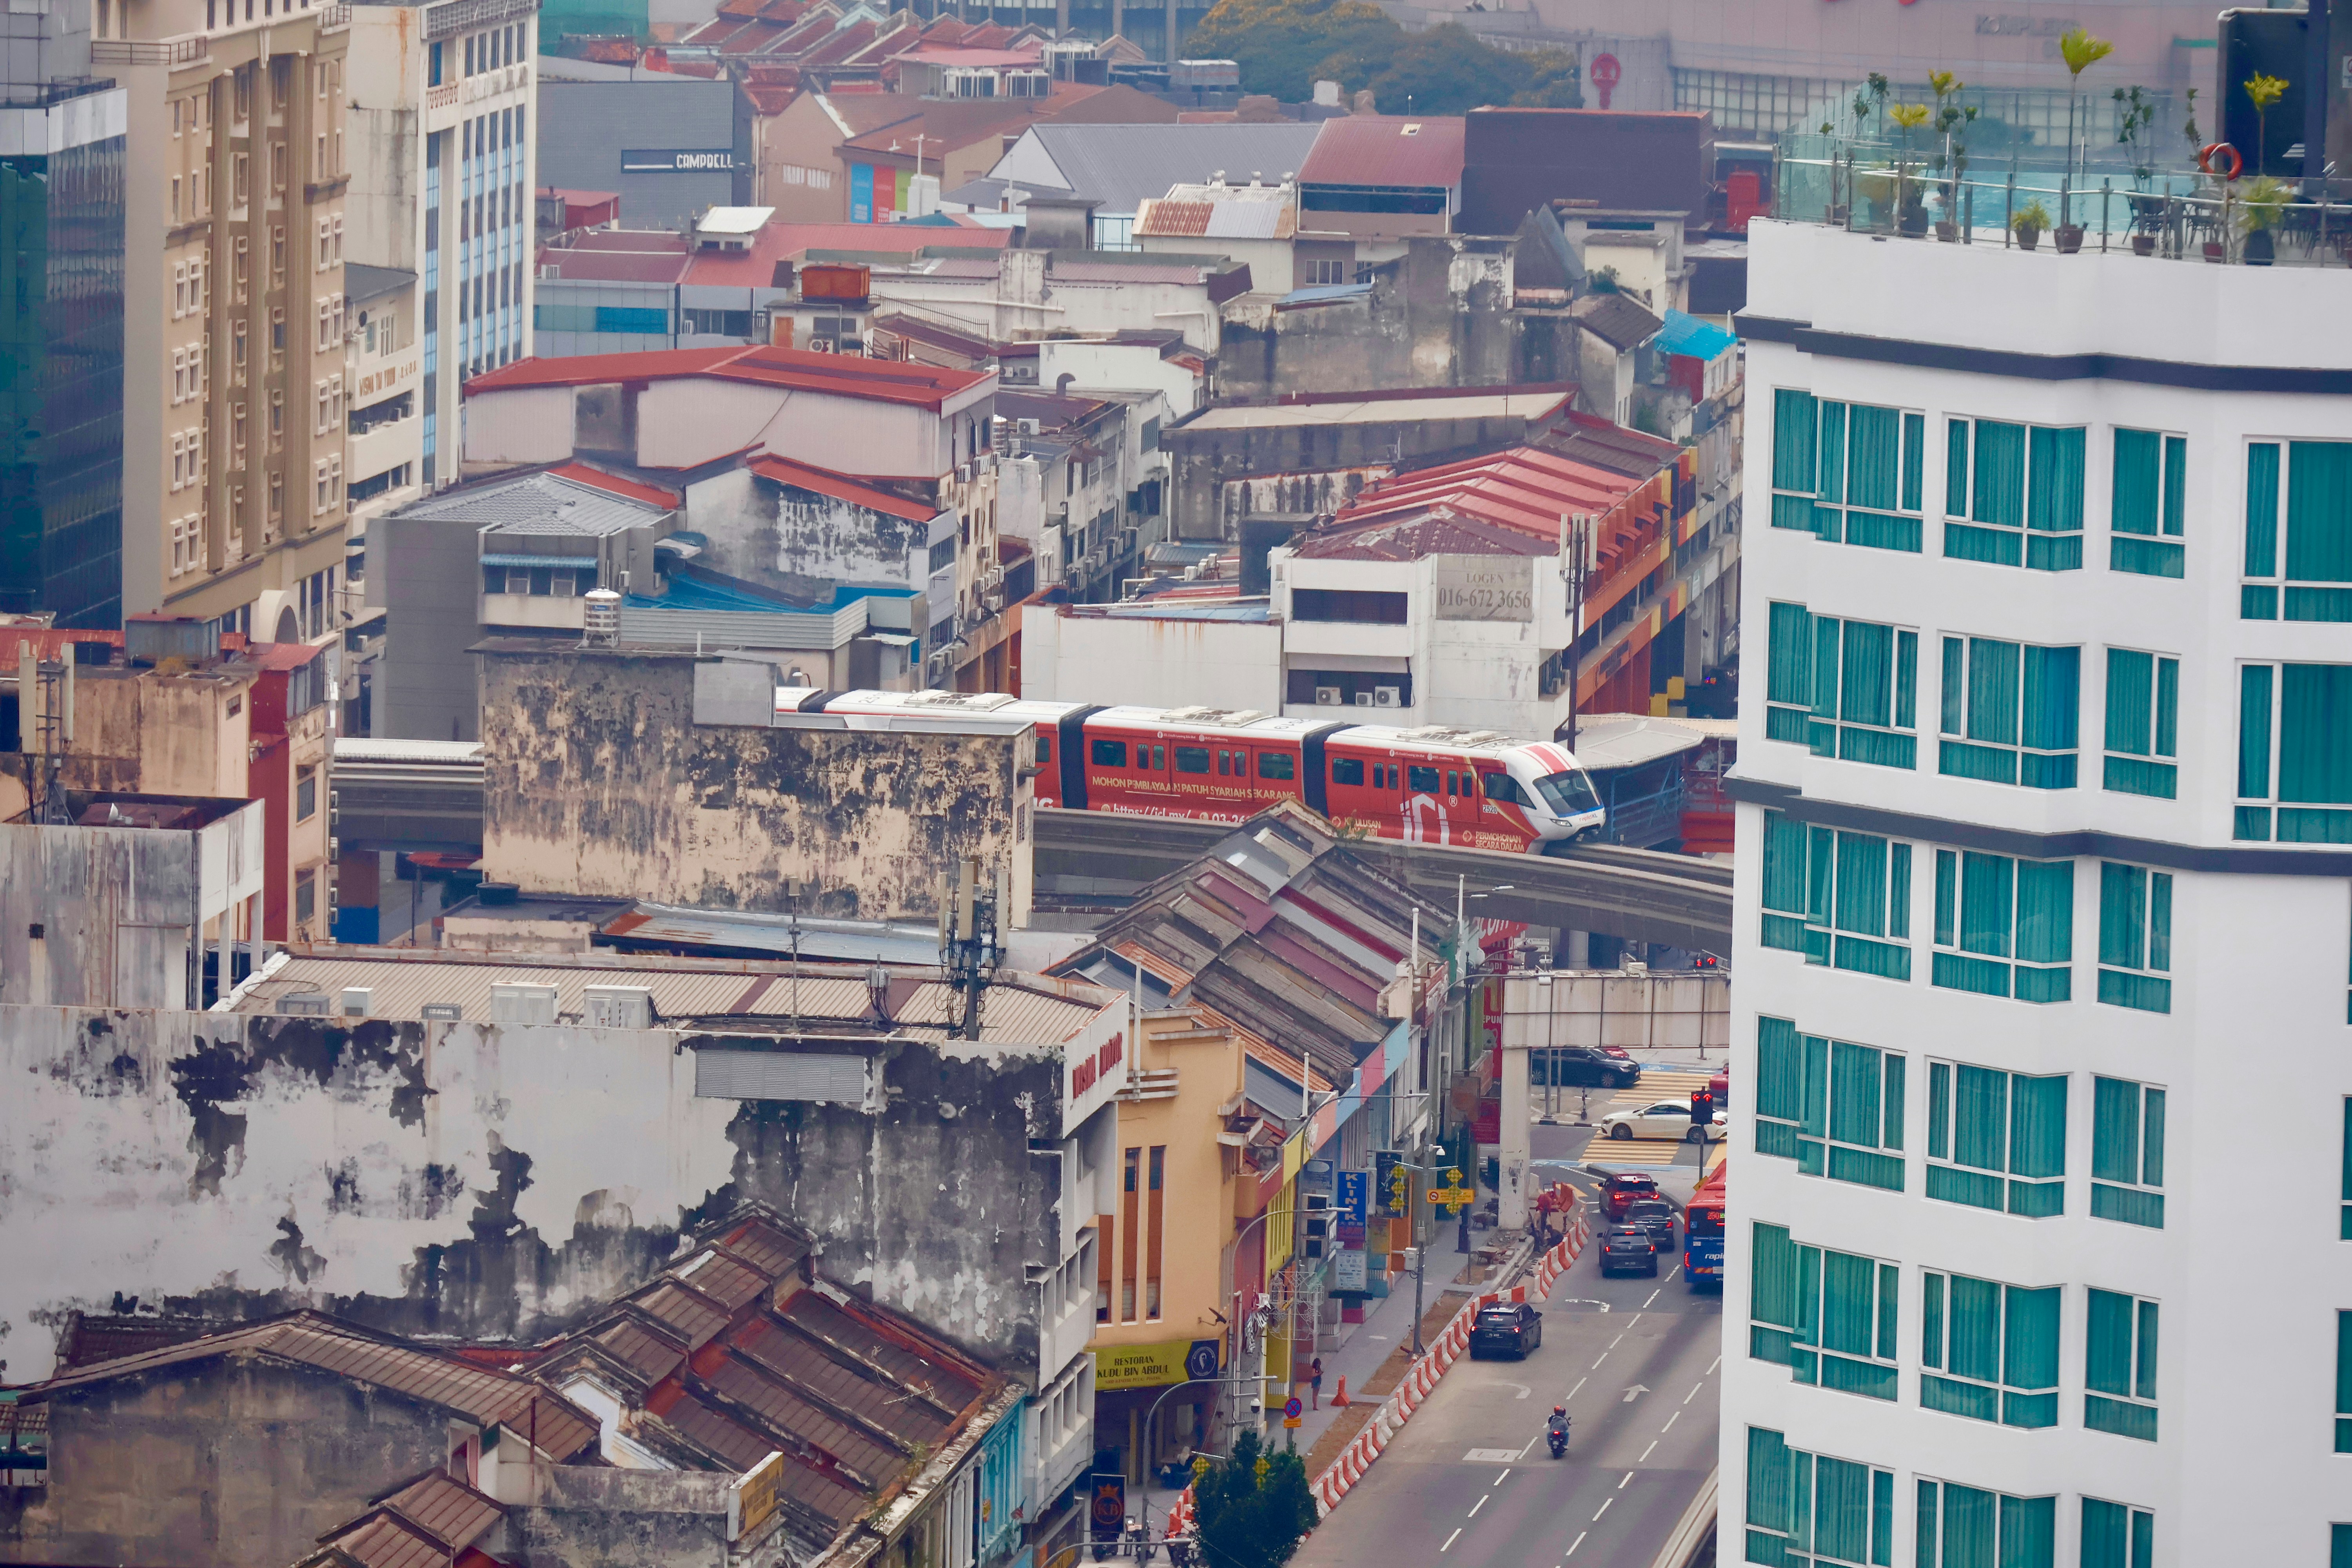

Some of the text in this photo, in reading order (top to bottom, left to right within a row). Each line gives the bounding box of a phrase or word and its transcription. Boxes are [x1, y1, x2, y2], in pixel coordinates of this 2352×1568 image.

[1466, 573, 1503, 583] LOGEN
[1439, 588, 1530, 608] 016-672 3656
[1093, 776, 1296, 800] MOHON PEMBIAYAAN PATUH SYARIAH SEKARANG
[1483, 805, 1497, 813] 2520
[1345, 817, 1381, 828] KULUSAN
[1579, 813, 1598, 822] rapidKL
[1475, 831, 1521, 843] PERMOHONAN
[1475, 840, 1524, 852] SECARA DALAM
[1344, 1174, 1358, 1221] KLINIK
[1114, 1356, 1154, 1366] RESTORAN
[1098, 1365, 1169, 1378] KUDU BIN ABDUL
